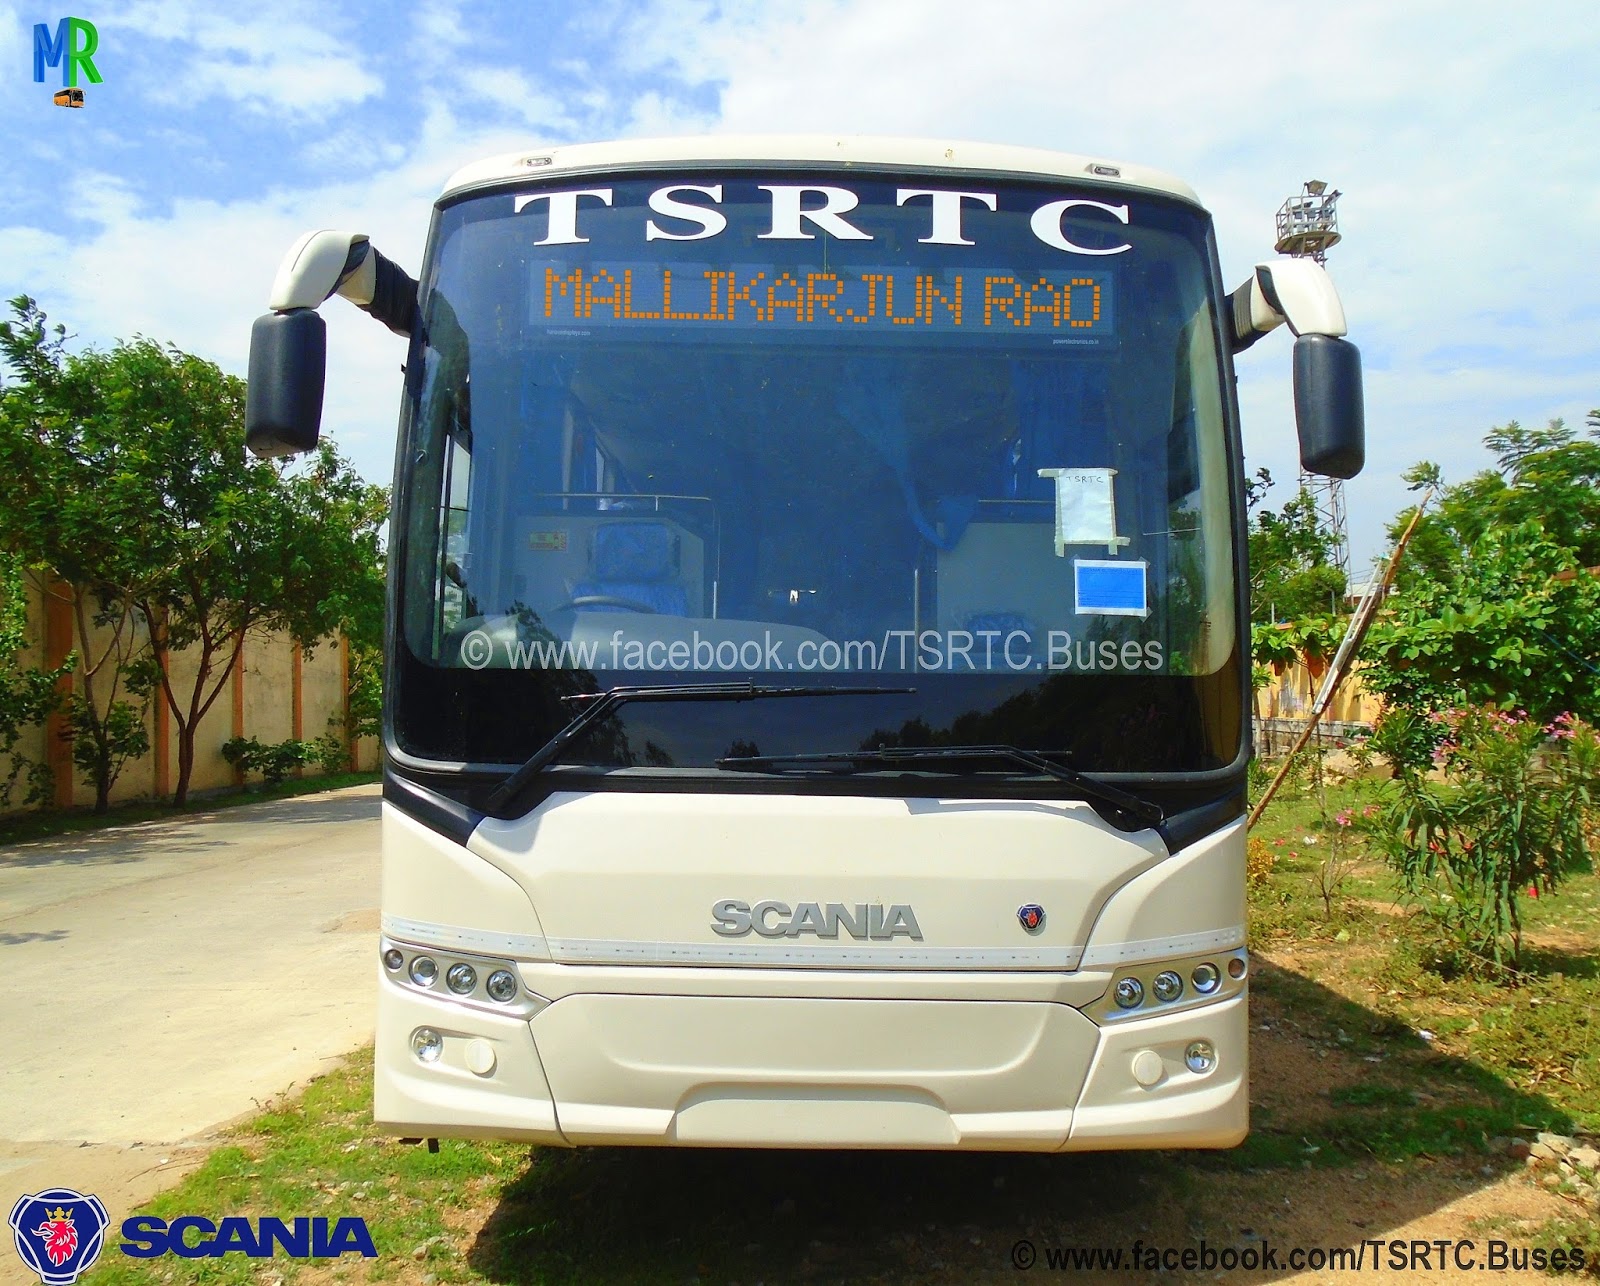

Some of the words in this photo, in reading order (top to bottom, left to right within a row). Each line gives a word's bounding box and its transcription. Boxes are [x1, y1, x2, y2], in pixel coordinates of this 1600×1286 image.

[513, 184, 1133, 256] TSRTC
[544, 267, 963, 325] MALLIKARJUN
[984, 275, 1101, 327] RAO
[1065, 475, 1104, 484] TSRTC
[710, 899, 924, 942] SCANIA
